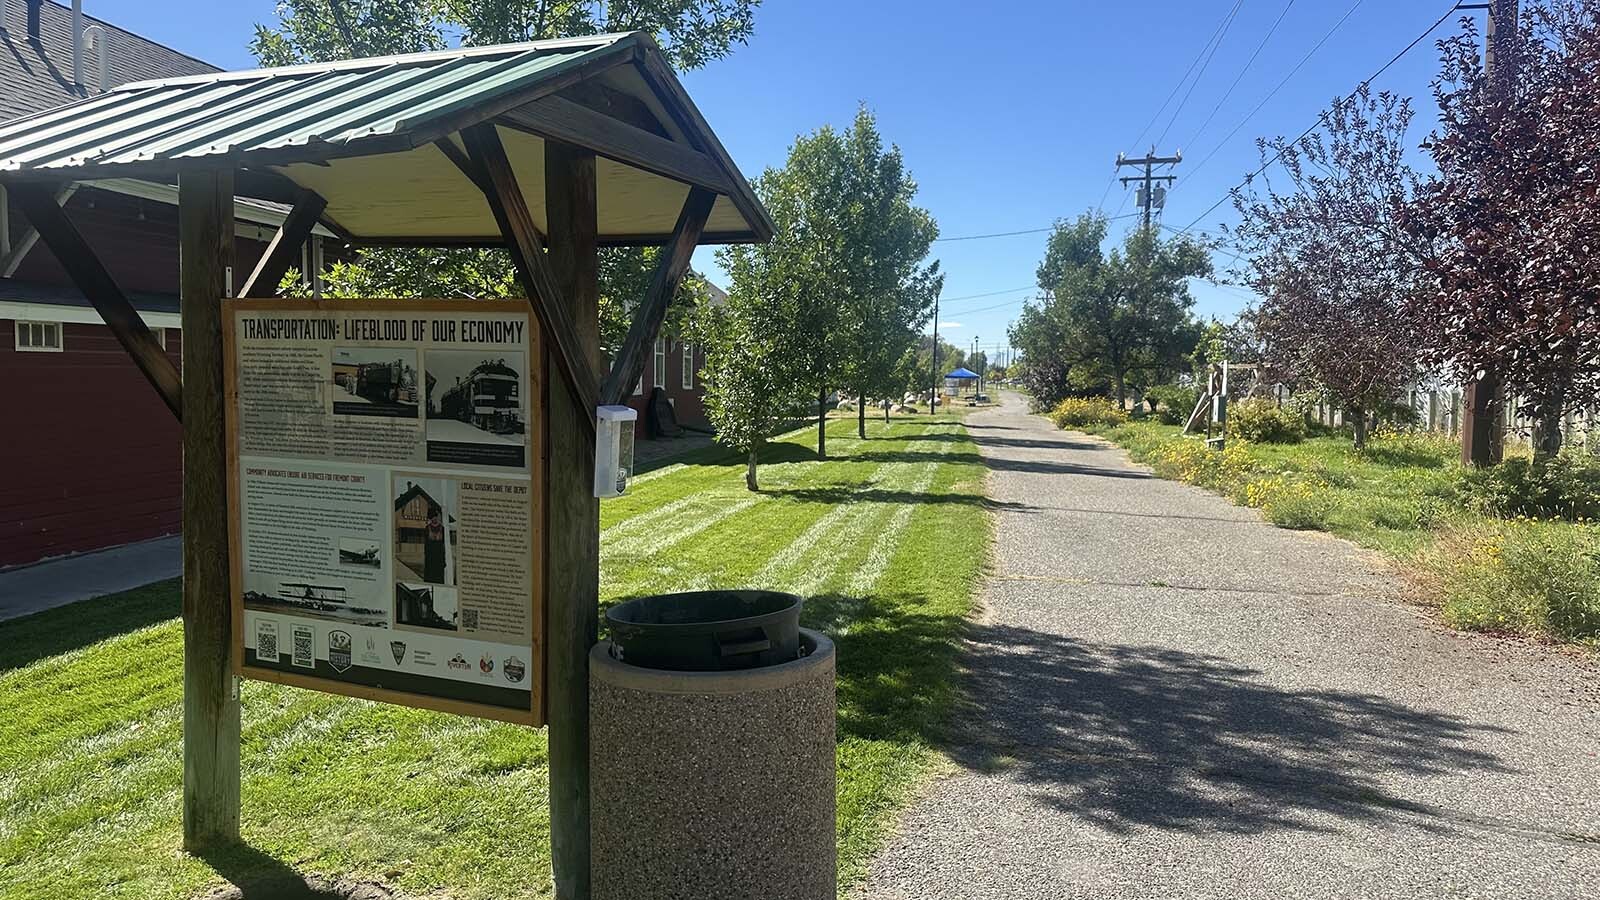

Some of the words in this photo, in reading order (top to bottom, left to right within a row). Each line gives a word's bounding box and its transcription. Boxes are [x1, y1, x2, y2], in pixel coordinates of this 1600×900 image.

[242, 318, 340, 341] TRANSPORTATION:
[344, 319, 407, 341] LIFEBLOOD
[411, 319, 427, 342] OF
[431, 320, 456, 343] OUR
[461, 320, 524, 344] ECONOMY
[461, 482, 473, 490] LOCAL
